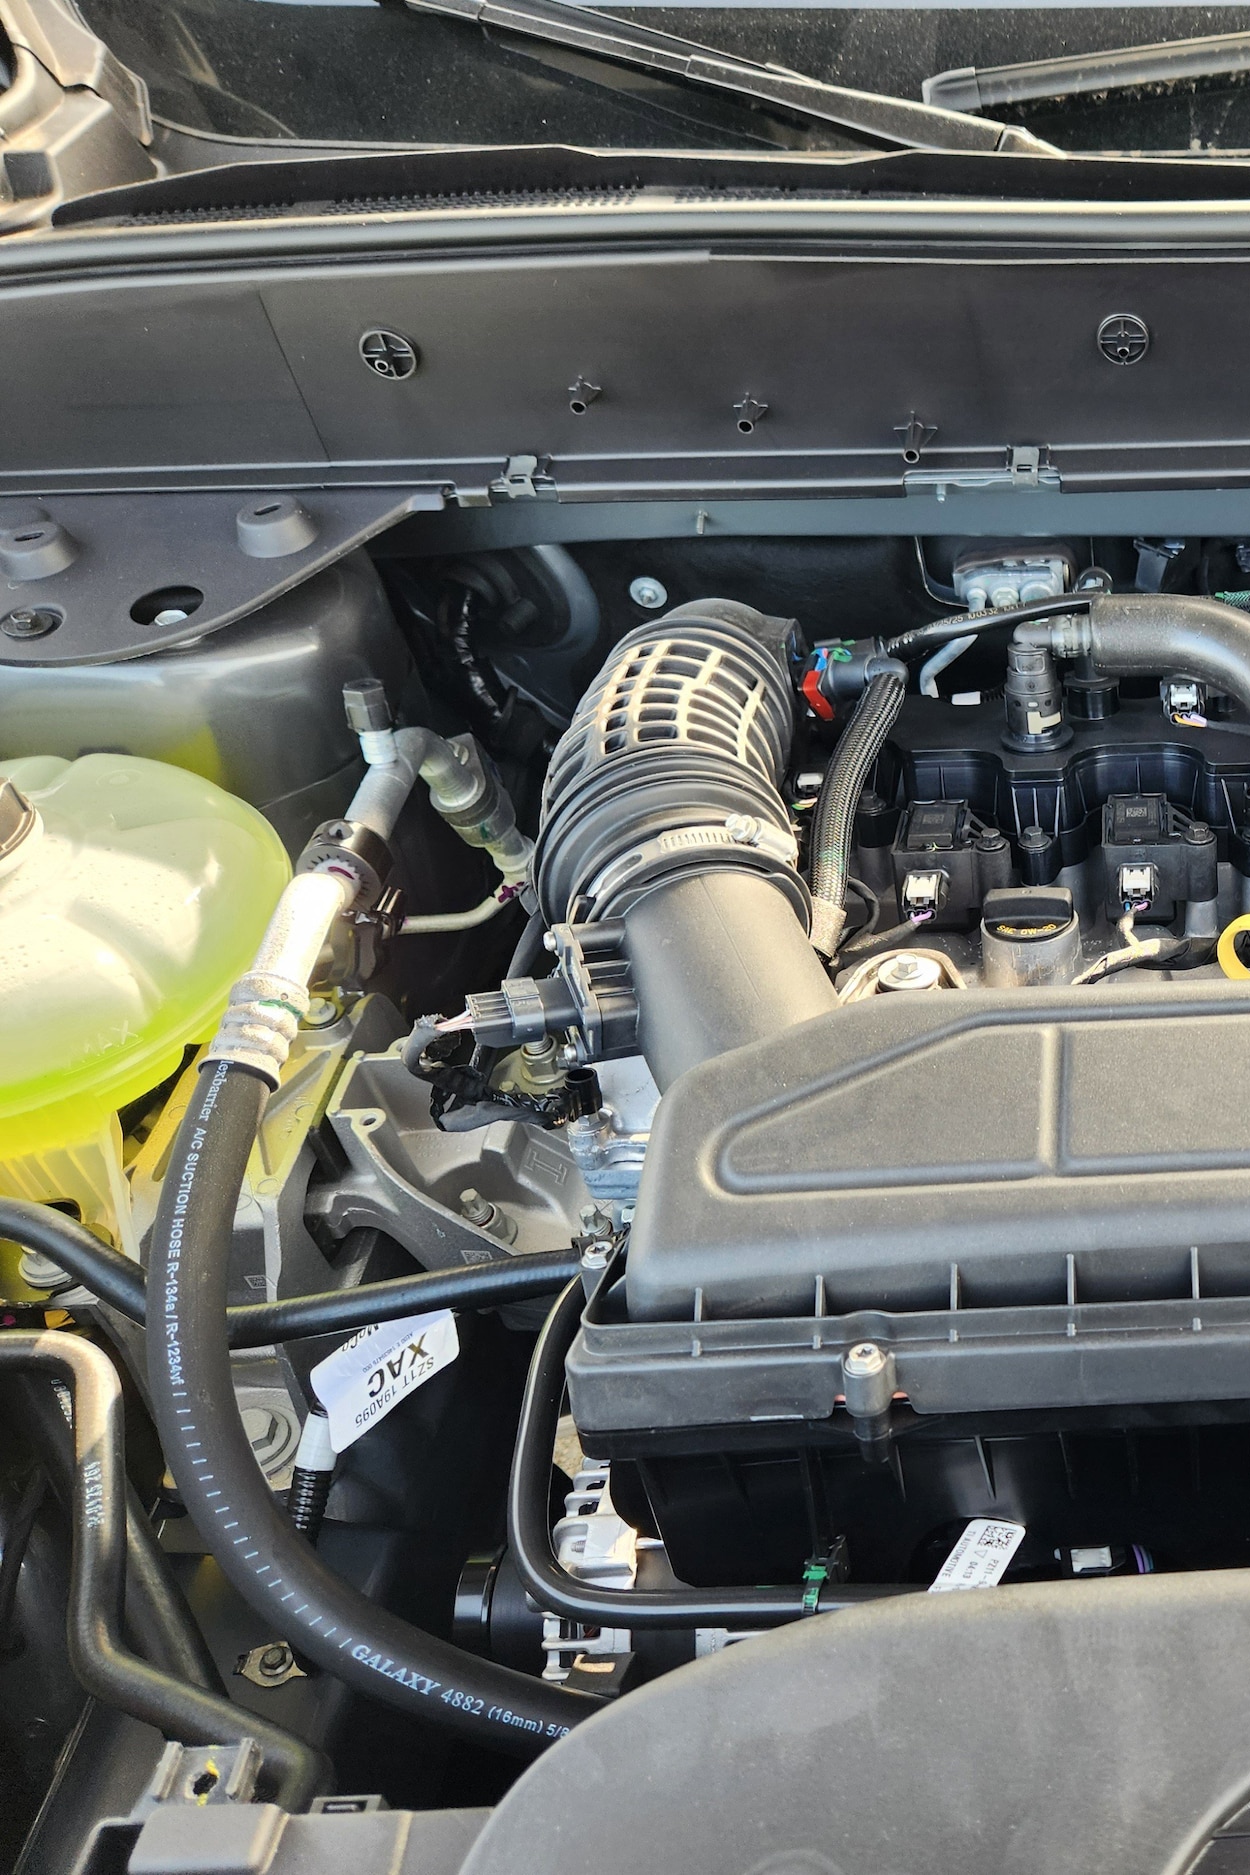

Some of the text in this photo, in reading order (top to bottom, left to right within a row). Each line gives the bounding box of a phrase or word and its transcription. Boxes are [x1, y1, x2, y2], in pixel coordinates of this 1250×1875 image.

[996, 924, 1017, 935] SAE
[190, 1127, 207, 1150] A/C
[174, 1153, 200, 1215] SUCTION
[168, 1218, 185, 1259] HOSE
[165, 1261, 180, 1312] R-134a
[355, 1356, 434, 1428] SZ1T 19A095
[367, 1332, 430, 1398] XAC
[351, 1644, 442, 1696] GALAXY
[441, 1688, 486, 1715] 4882
[488, 1705, 544, 1734] (16mm)
